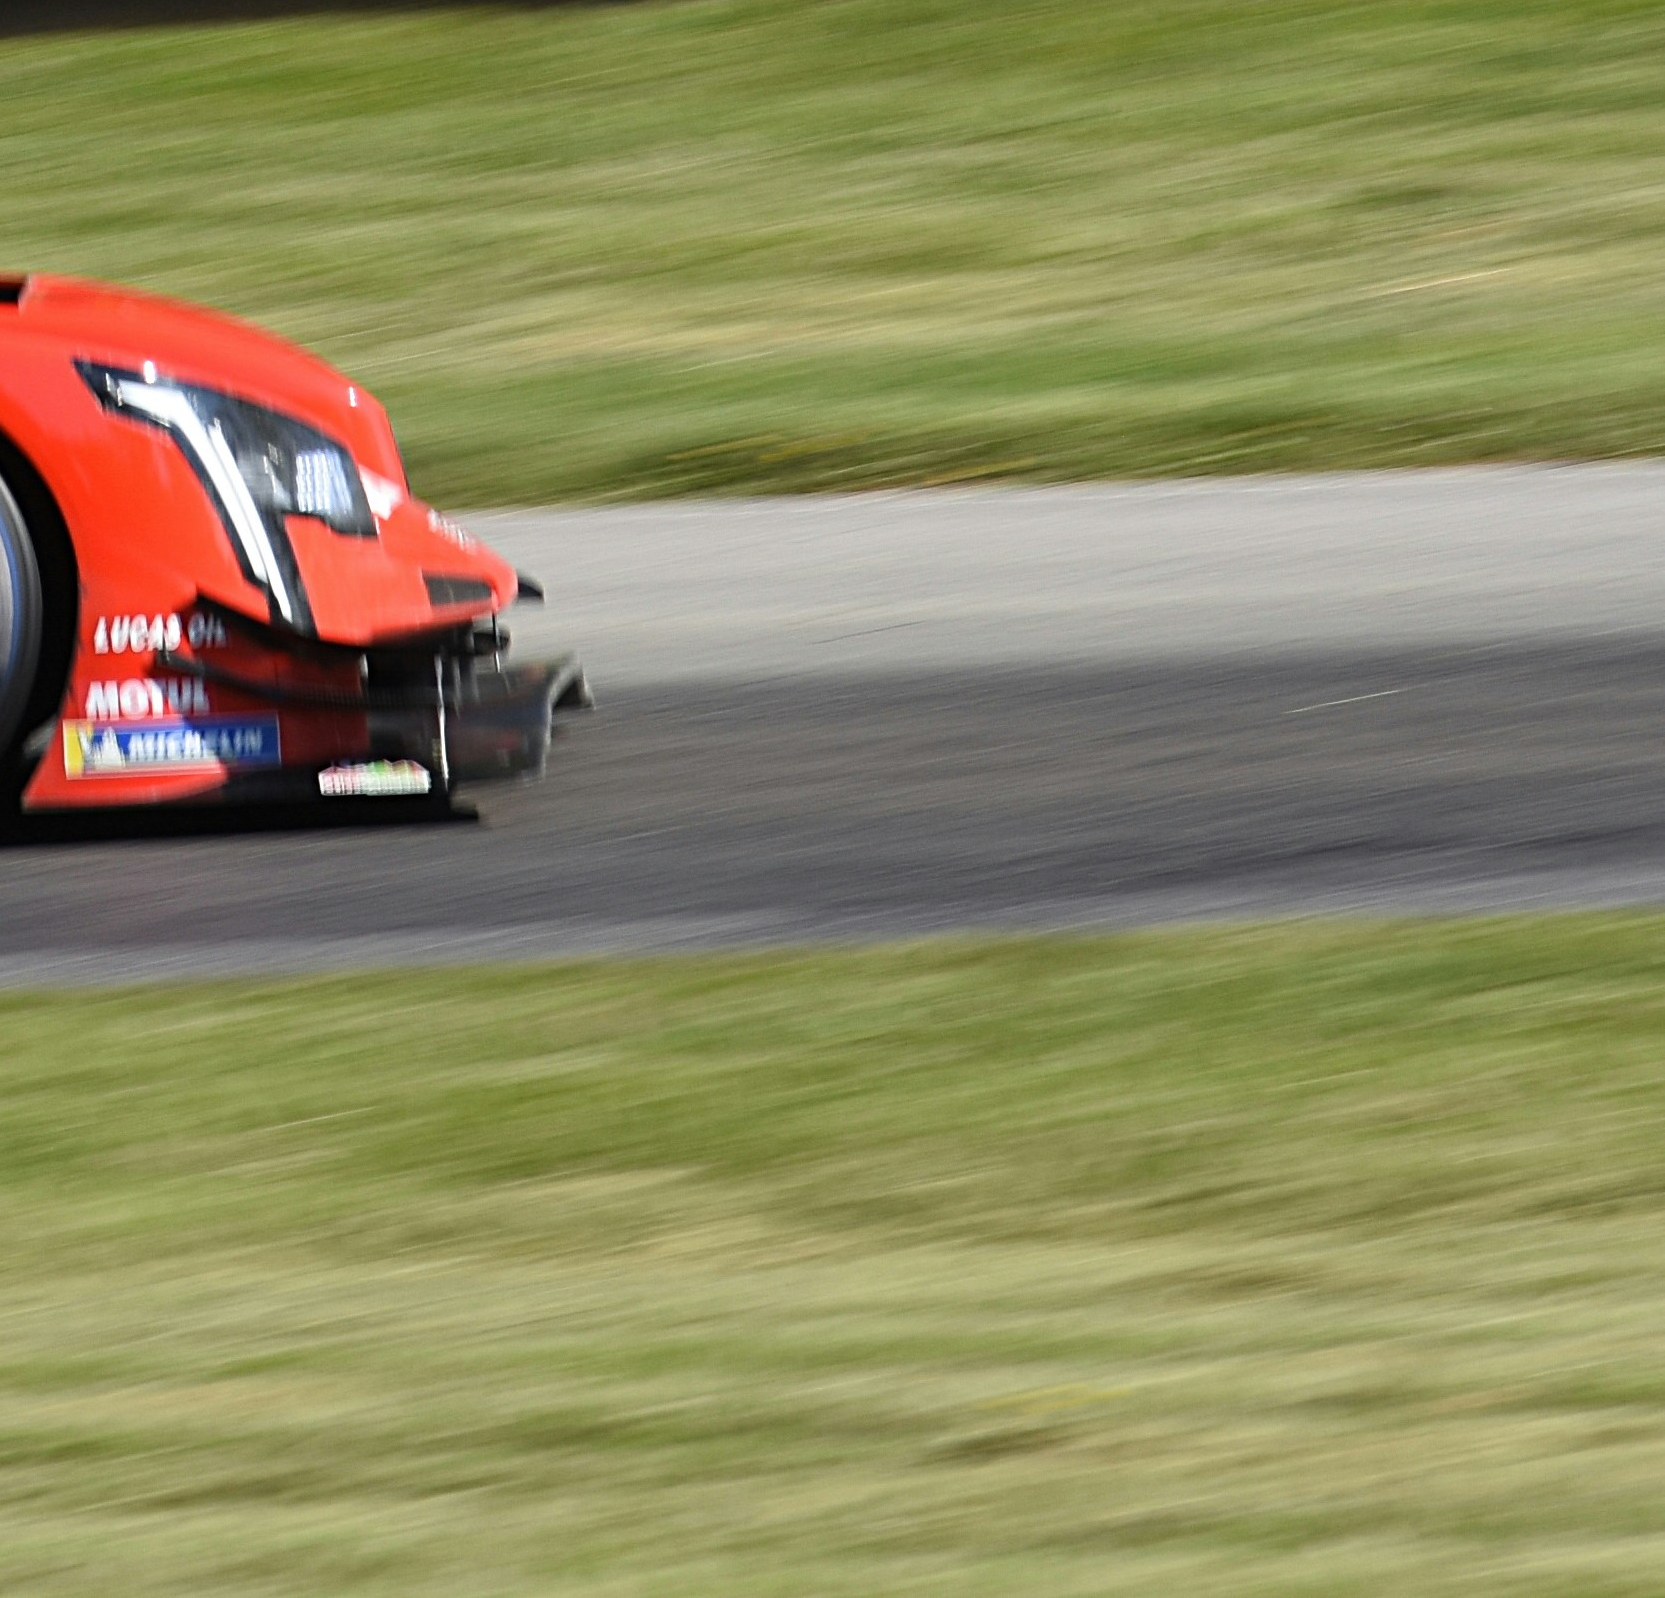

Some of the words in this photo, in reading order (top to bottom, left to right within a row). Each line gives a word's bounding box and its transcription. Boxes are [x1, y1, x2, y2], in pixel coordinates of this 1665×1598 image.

[94, 613, 182, 654] LUCAS
[85, 677, 210, 721] MOTUL
[128, 727, 263, 762] MICHELIN
